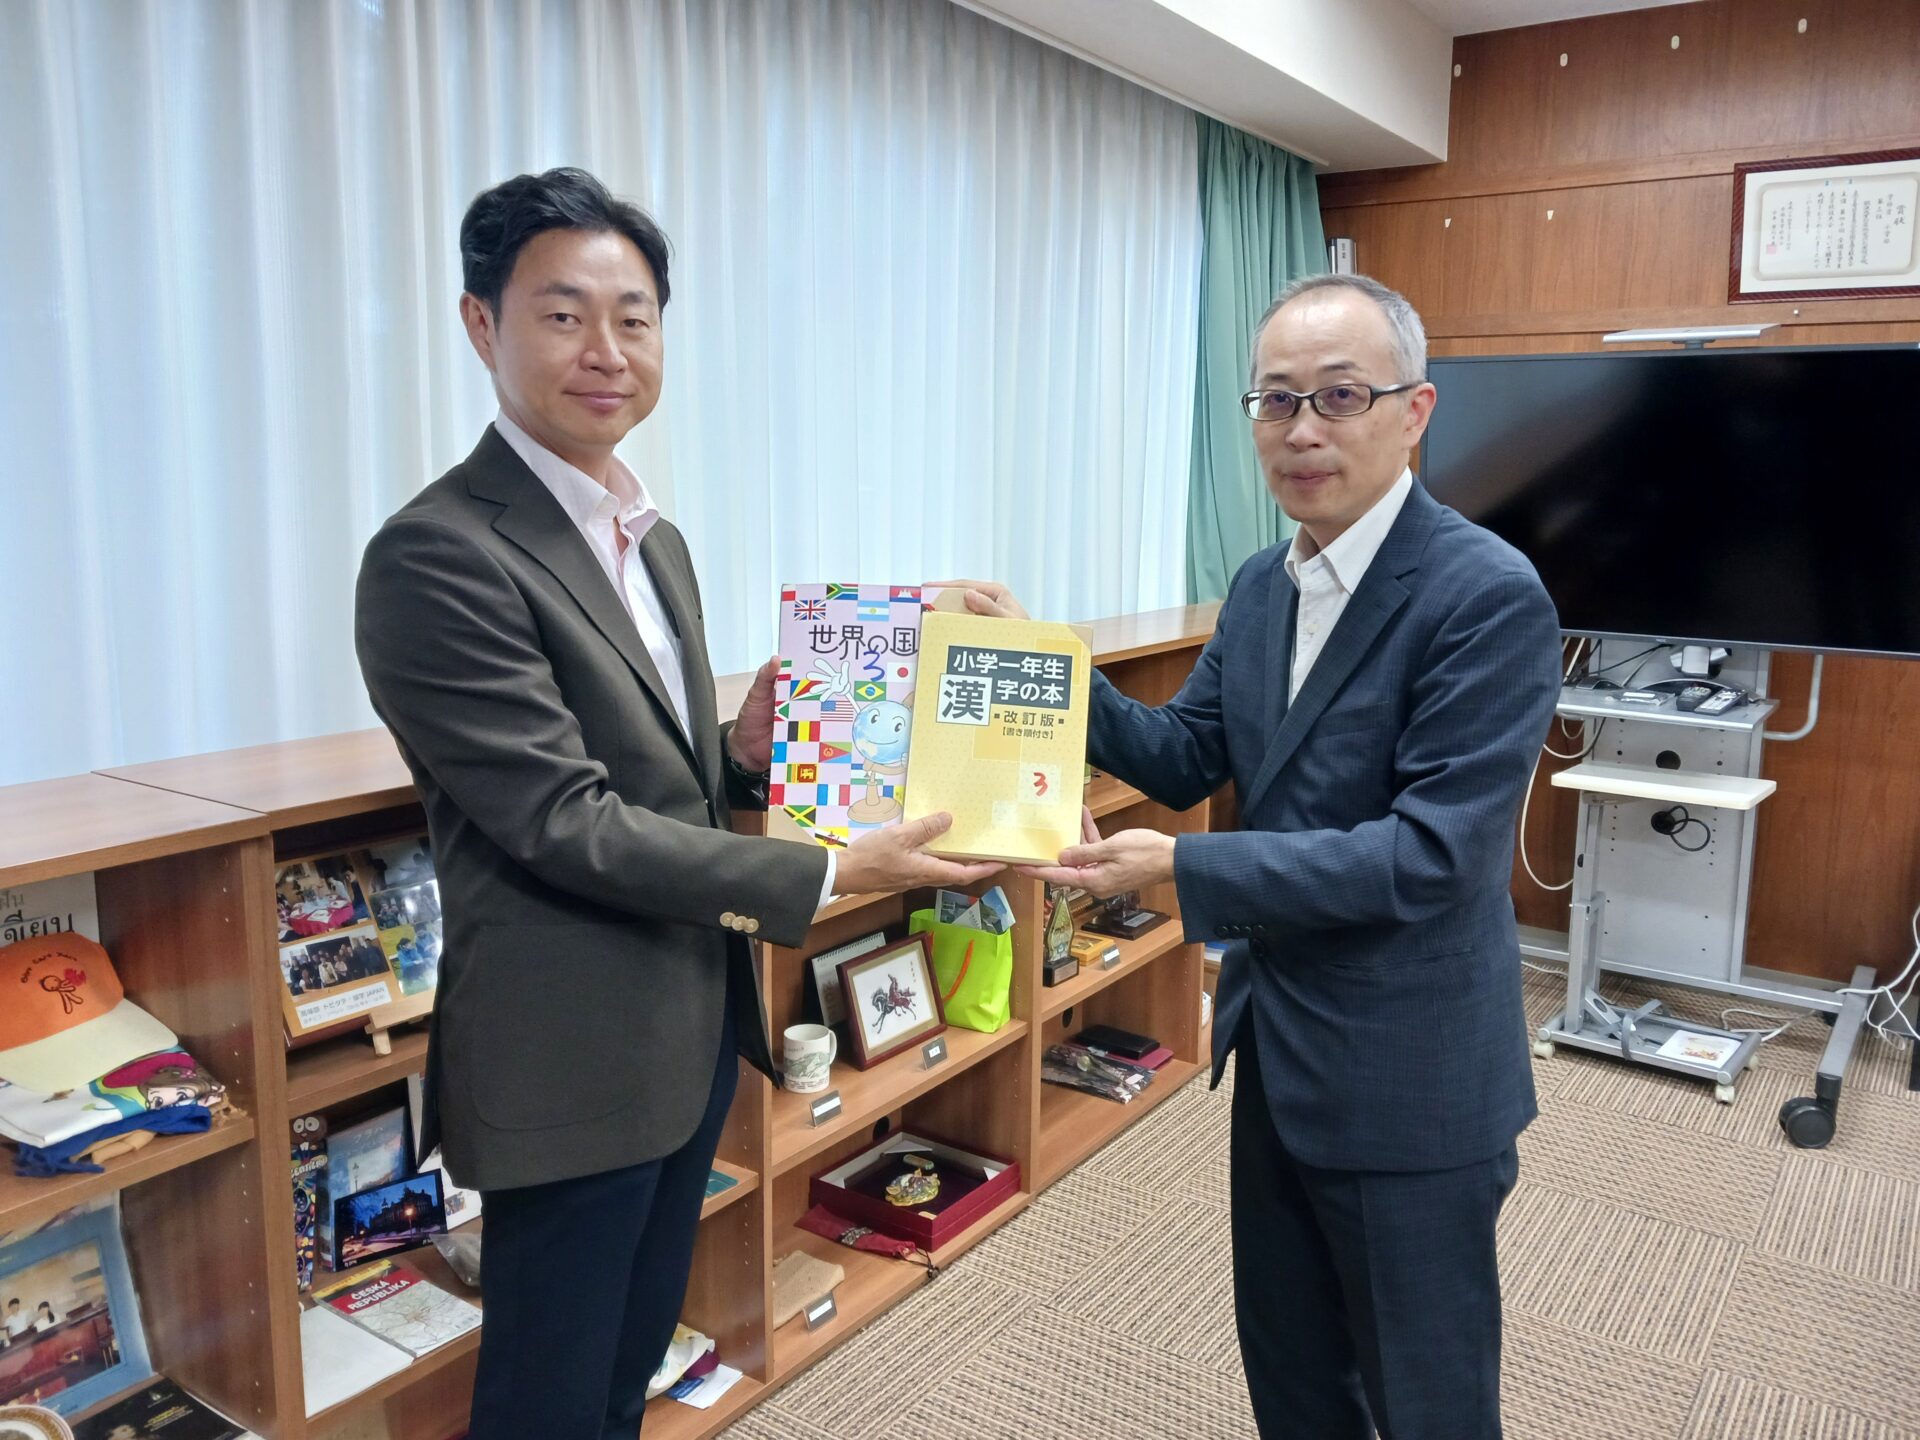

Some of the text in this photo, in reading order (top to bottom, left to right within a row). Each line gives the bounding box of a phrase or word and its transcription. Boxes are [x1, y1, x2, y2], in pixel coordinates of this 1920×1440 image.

[808, 624, 919, 660] 世界の国
[953, 651, 1065, 680] 小学一年生
[1003, 710, 1055, 727] 改訂版
